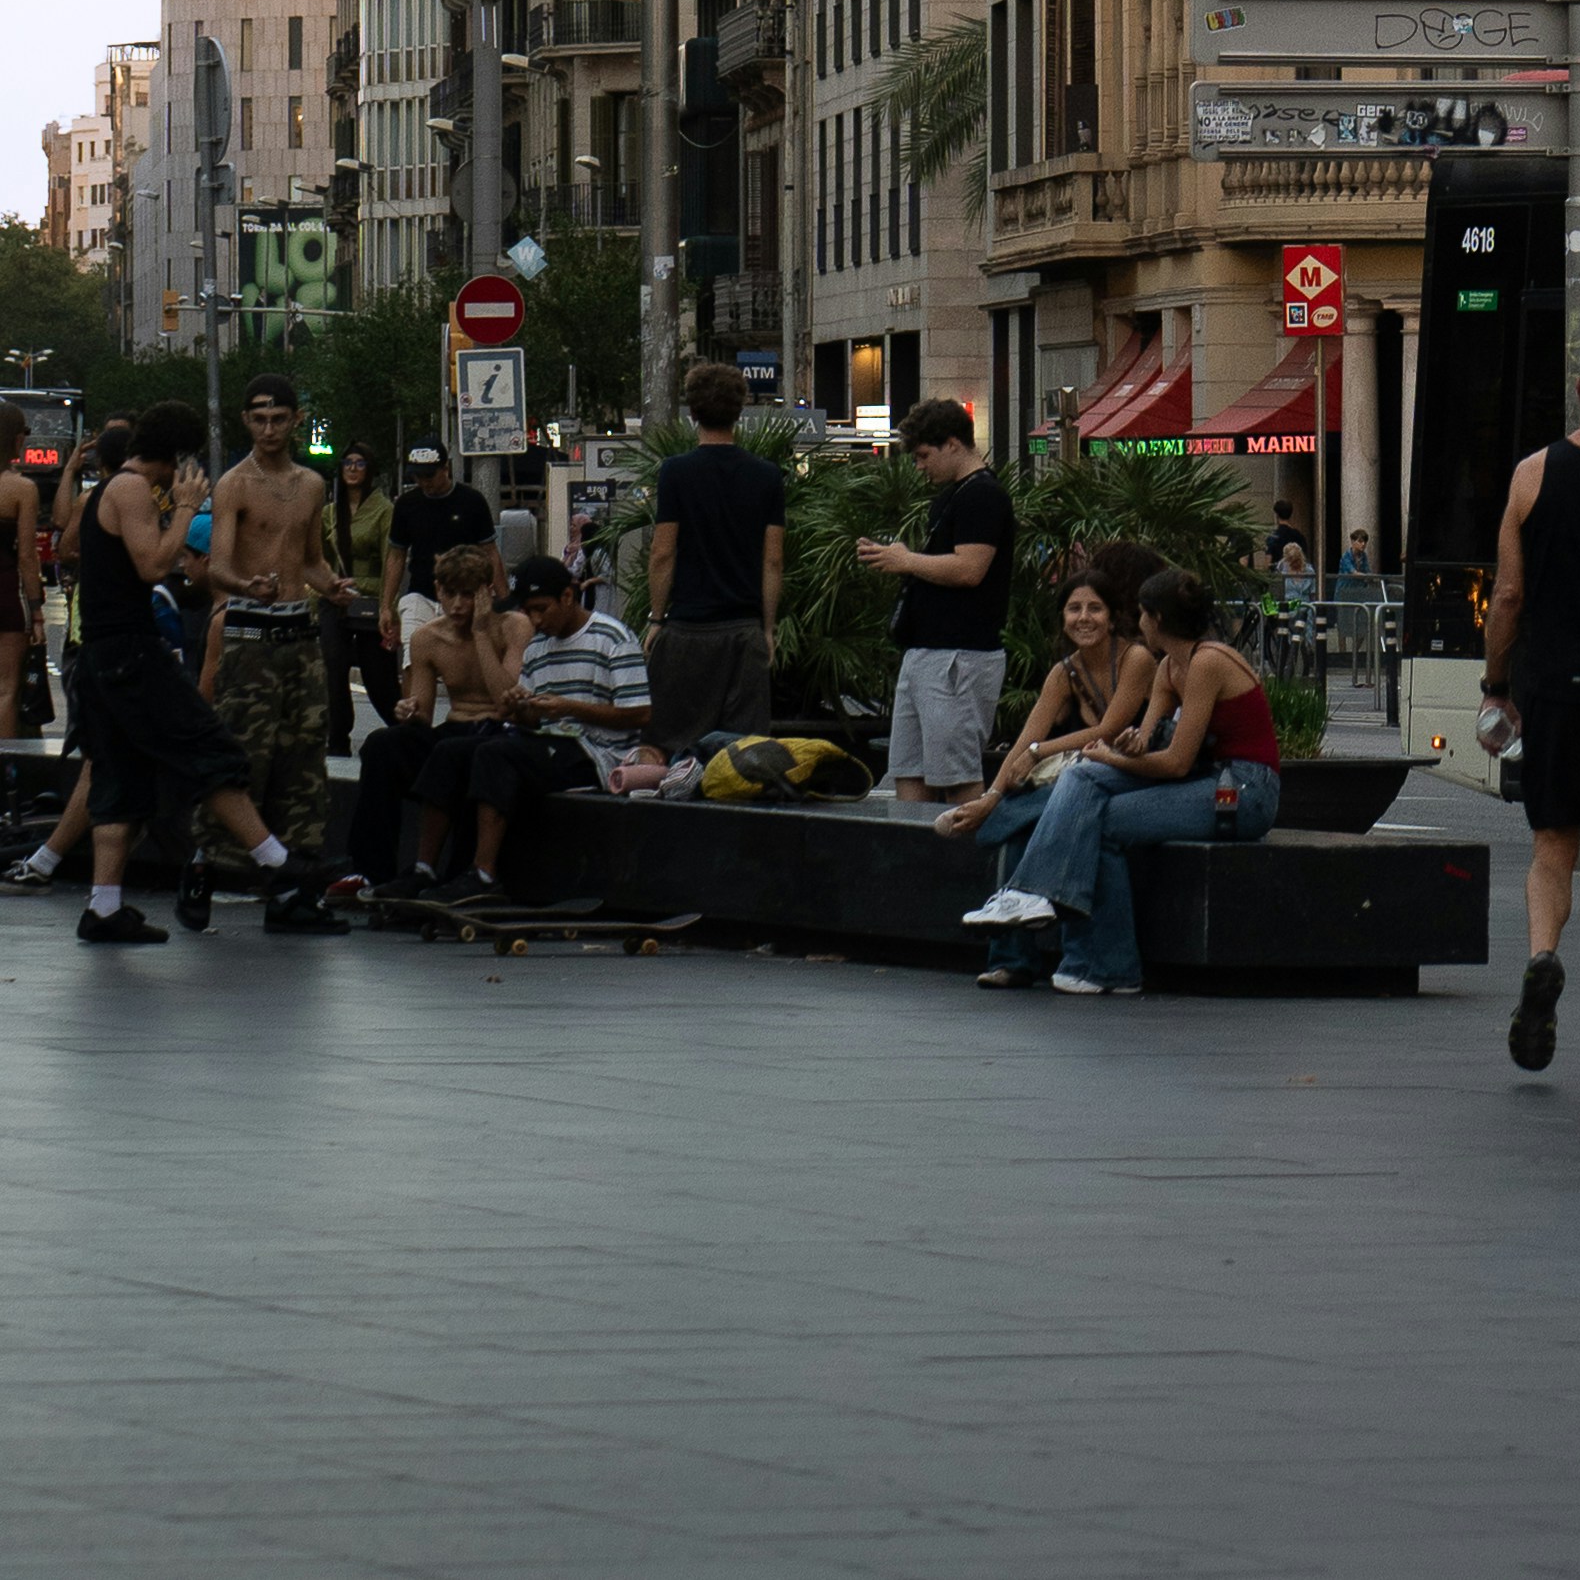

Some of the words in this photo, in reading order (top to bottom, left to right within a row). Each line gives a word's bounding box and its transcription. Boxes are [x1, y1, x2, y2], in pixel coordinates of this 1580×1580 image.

[1462, 226, 1495, 254] 4618
[1300, 267, 1322, 288] M
[742, 366, 775, 379] ATM
[25, 448, 58, 465] ROJA
